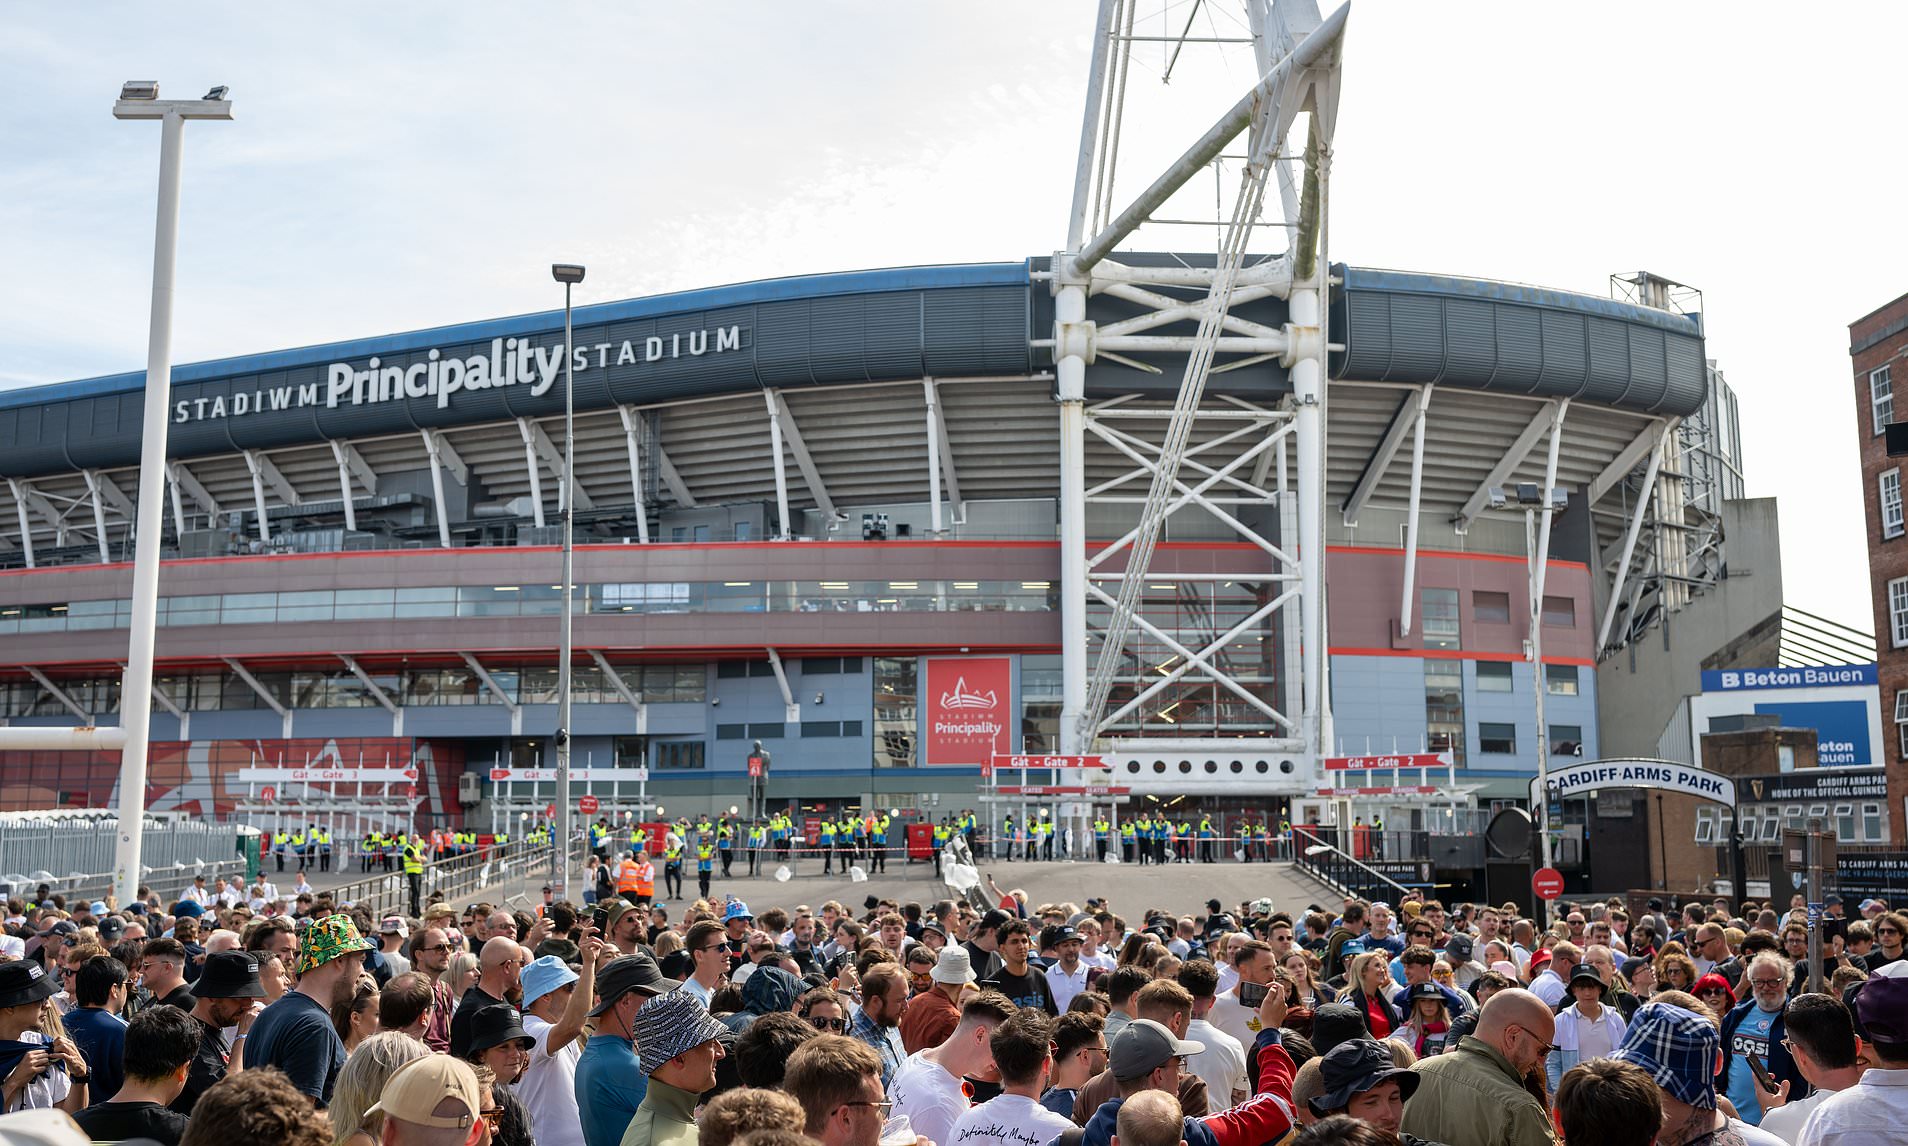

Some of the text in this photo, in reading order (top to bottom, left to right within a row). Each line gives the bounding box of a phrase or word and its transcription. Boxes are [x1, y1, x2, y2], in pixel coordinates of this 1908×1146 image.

[175, 325, 742, 424] STADIWM Principality STADIUM
[1744, 671, 1801, 687] Beton
[1805, 669, 1864, 684] Bauen
[935, 721, 1002, 736] Principality
[1817, 741, 1854, 753] eton
[1043, 757, 1068, 767] Gate
[1077, 757, 1085, 767] 2
[1377, 757, 1400, 768] Gate
[1407, 757, 1415, 766] 2
[1817, 752, 1855, 764] auen
[322, 770, 344, 780] Gate
[352, 770, 358, 779] 3
[583, 770, 589, 779] 3
[1547, 766, 1724, 795] CARDIFF ARMS PARK
[1817, 777, 1849, 788] CARDIFF
[1849, 775, 1872, 787] ARMS
[1771, 789, 1792, 799] HOME
[1792, 788, 1802, 798] OF
[1803, 787, 1818, 798] THE
[1818, 785, 1851, 798] OFFICIAL
[1838, 860, 1847, 869] TO
[1848, 860, 1877, 869] CARDIFF
[1879, 860, 1898, 869] ARMS
[957, 1122, 1040, 1146] Definitely Maybe
